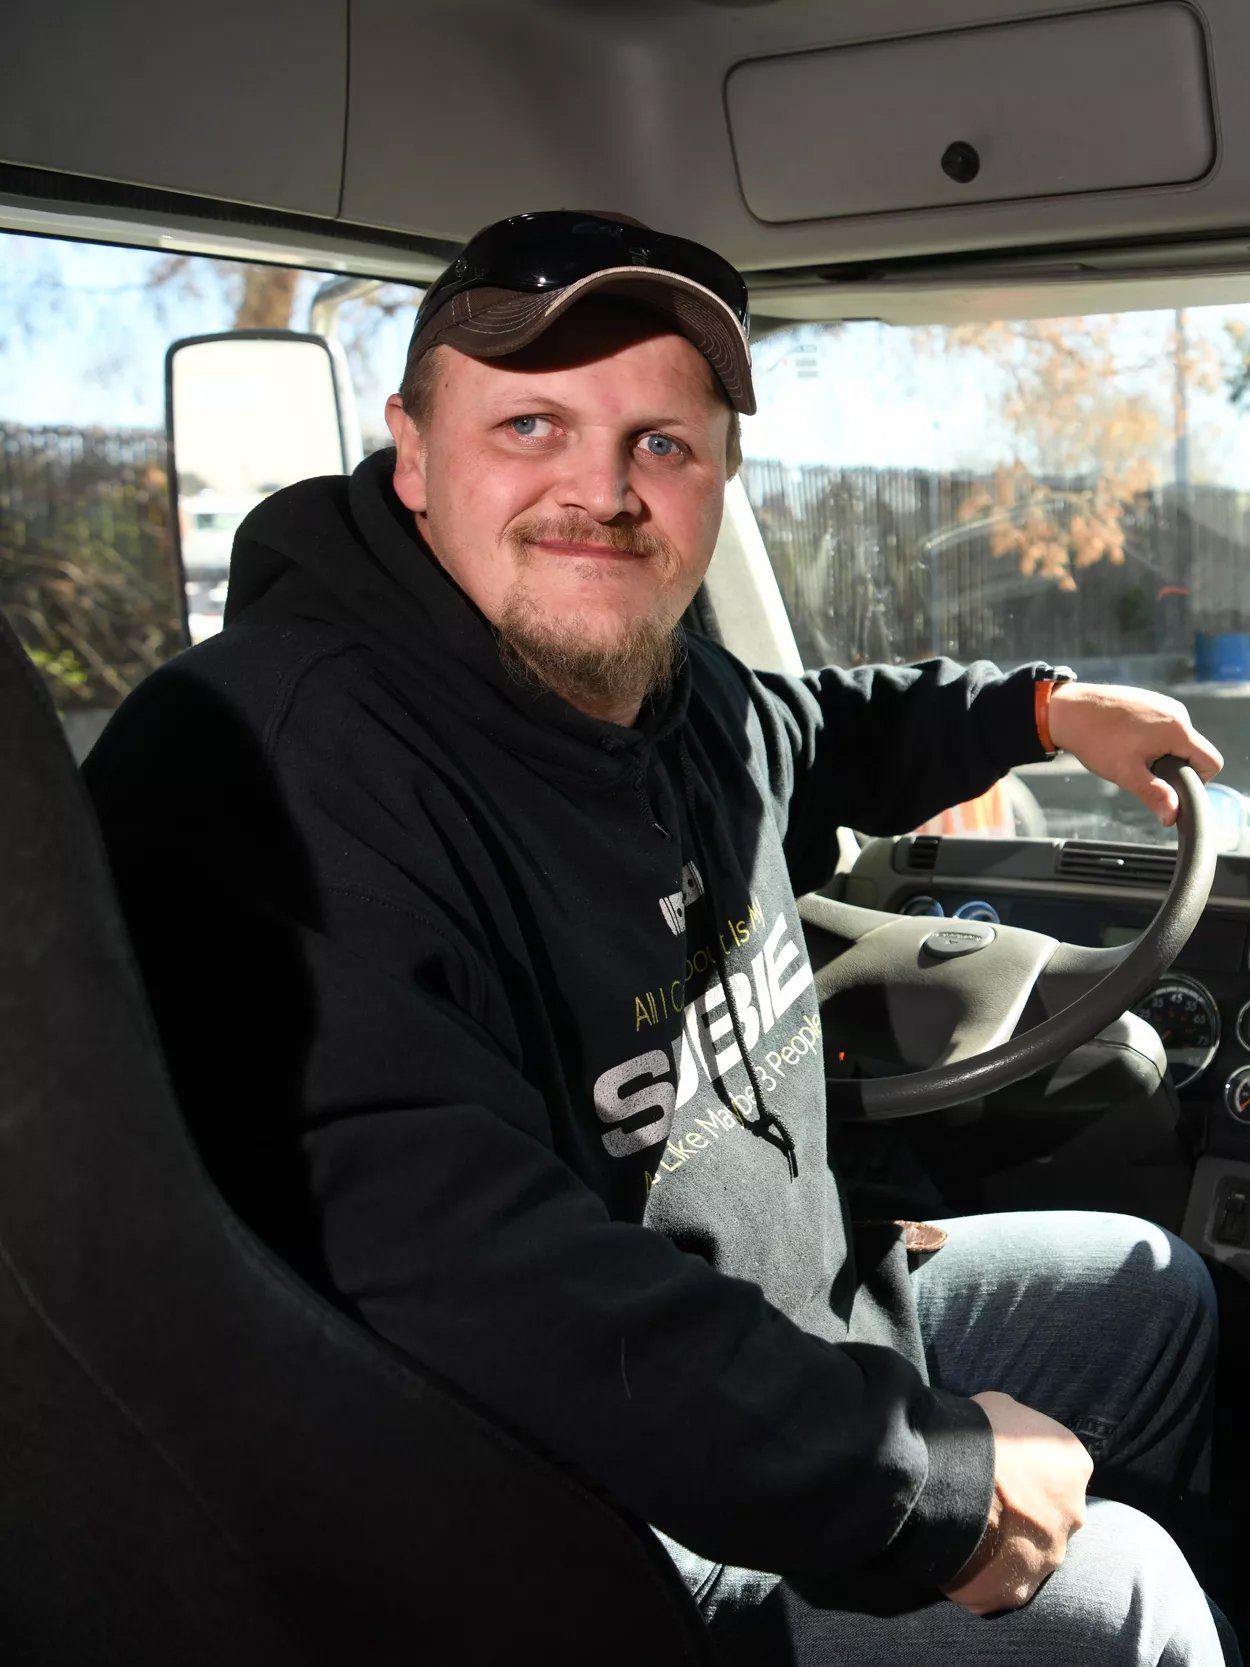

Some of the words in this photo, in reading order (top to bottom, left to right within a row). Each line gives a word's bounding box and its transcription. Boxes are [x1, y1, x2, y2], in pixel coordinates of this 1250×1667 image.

[634, 991, 660, 1032] All
[727, 919, 751, 947] Is
[660, 1131, 709, 1173] Like
[754, 1065, 778, 1092] 3
